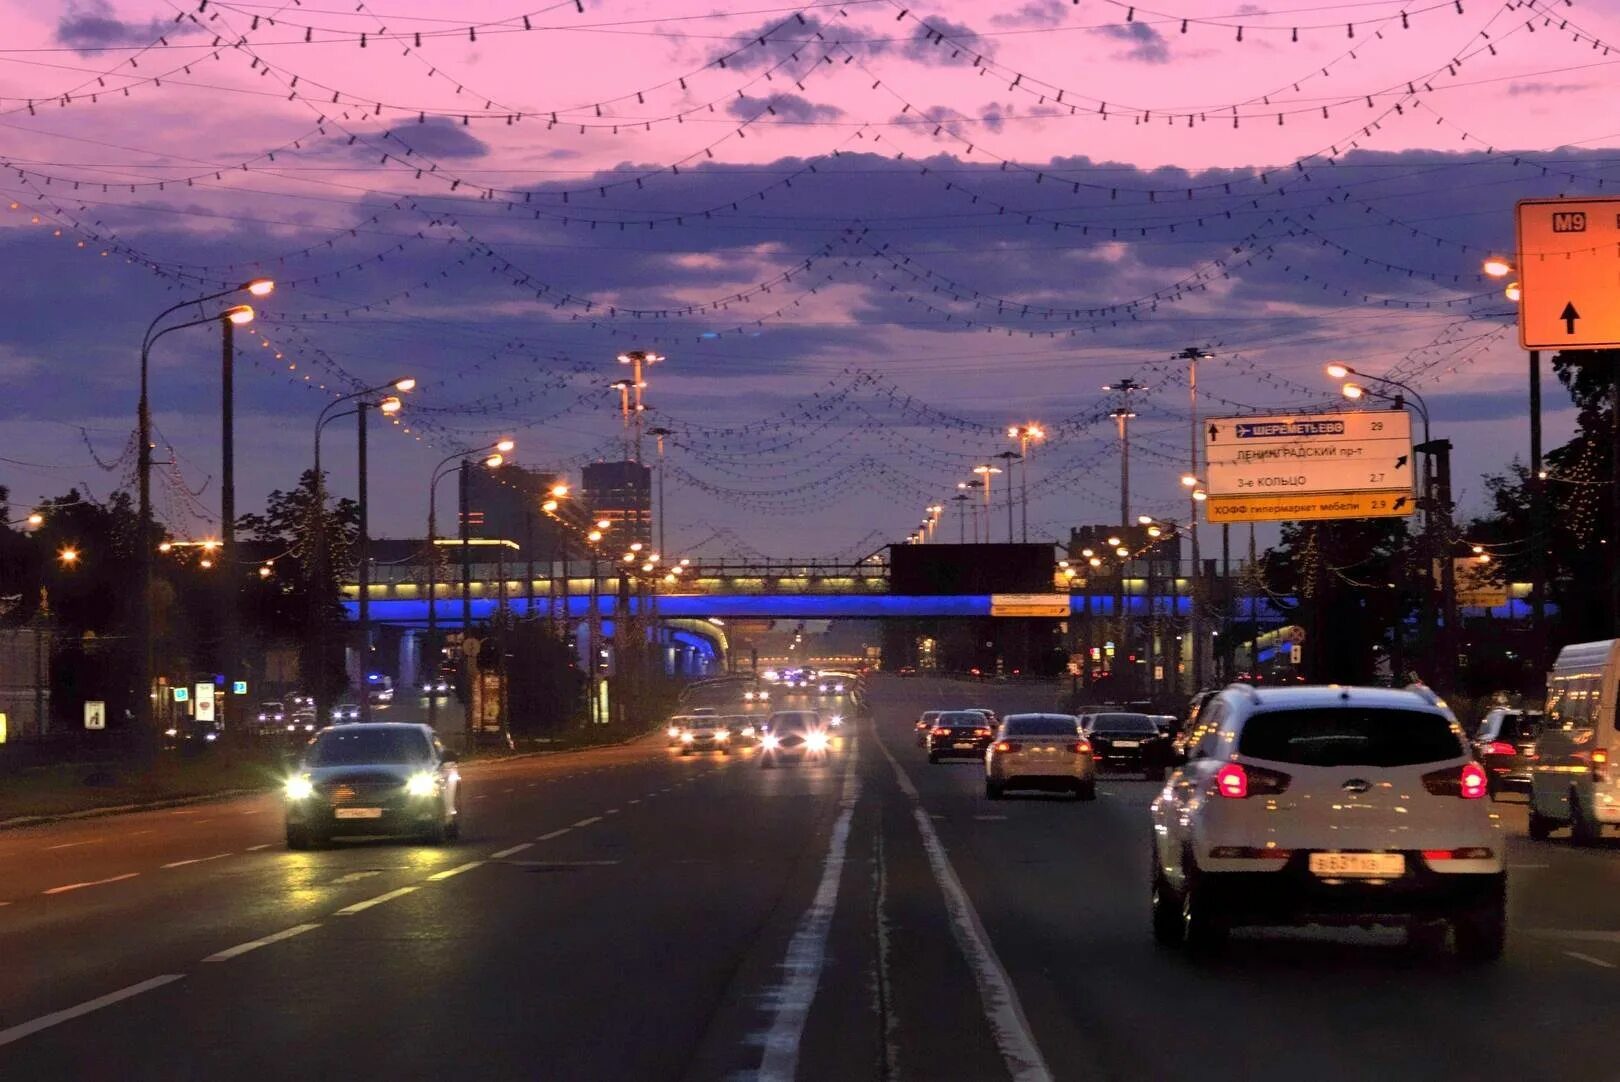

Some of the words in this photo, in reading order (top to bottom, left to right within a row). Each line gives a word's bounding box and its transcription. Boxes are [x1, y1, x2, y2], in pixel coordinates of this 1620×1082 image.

[1555, 214, 1584, 231] М9
[1252, 422, 1344, 436] ШЕРЕМЕТЬЕВО
[1371, 421, 1383, 431] 29
[1237, 447, 1337, 460] ЛЕНИНГРАДСКИЙ
[1340, 447, 1363, 458] пр-т
[1257, 475, 1307, 487] КОЛЬЦО
[1369, 473, 1385, 483] 2.7
[1215, 505, 1247, 515] ХОФФ
[1250, 504, 1318, 515] гипермаркет
[1319, 501, 1360, 512] мебели
[1371, 500, 1386, 510] 2.9
